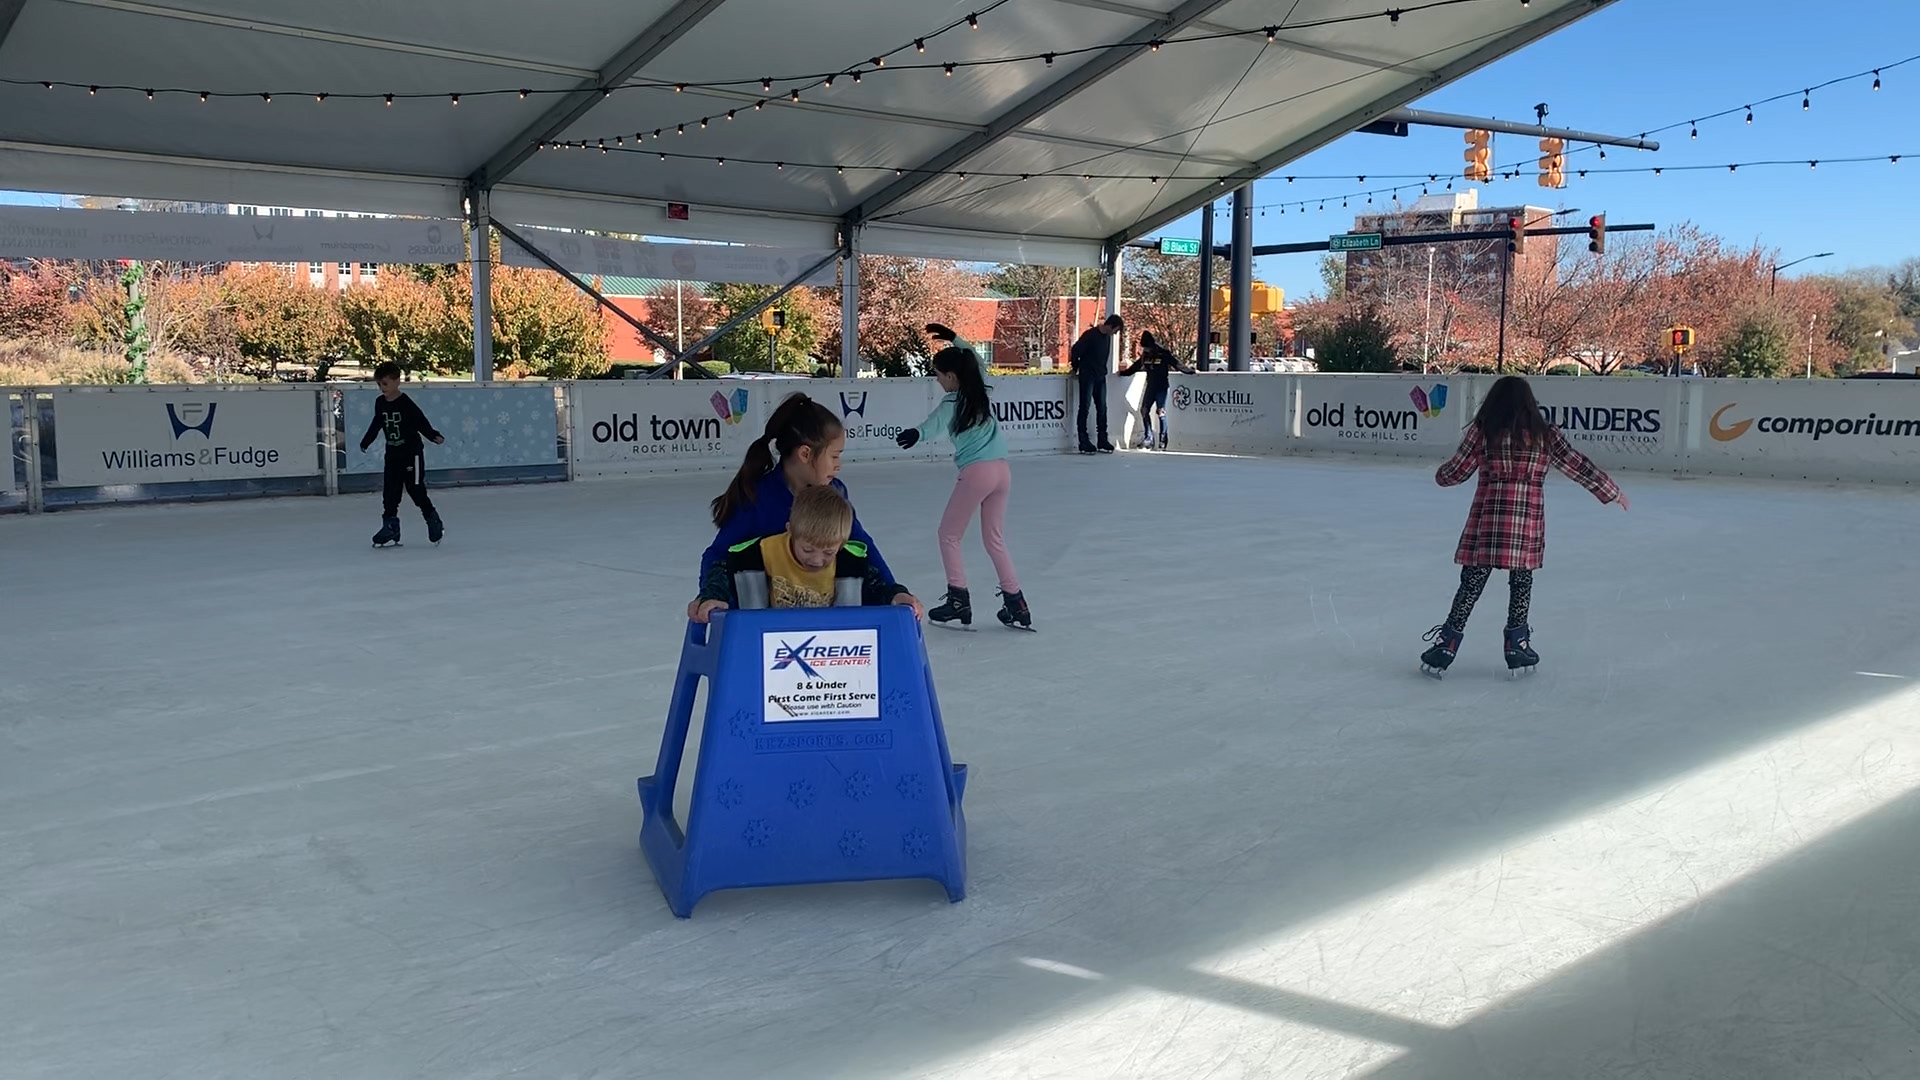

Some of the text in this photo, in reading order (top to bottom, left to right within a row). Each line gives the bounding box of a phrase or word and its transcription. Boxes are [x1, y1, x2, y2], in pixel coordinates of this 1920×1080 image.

[1170, 240, 1197, 253] Black St
[1341, 238, 1378, 247] Elizabeth Ln
[1306, 402, 1417, 430] old town
[592, 413, 721, 443] old town
[1757, 412, 1920, 441] comporium
[1338, 431, 1417, 441] ROCK HILL, SC
[1573, 433, 1659, 444] CREDIT UNION
[633, 442, 721, 454] ROCK HILL, SC
[810, 658, 871, 667] ICE CENTER
[797, 682, 803, 690] 8
[816, 681, 847, 689] Under
[793, 694, 822, 702] Come
[824, 693, 846, 701] First
[848, 692, 876, 700] Serve
